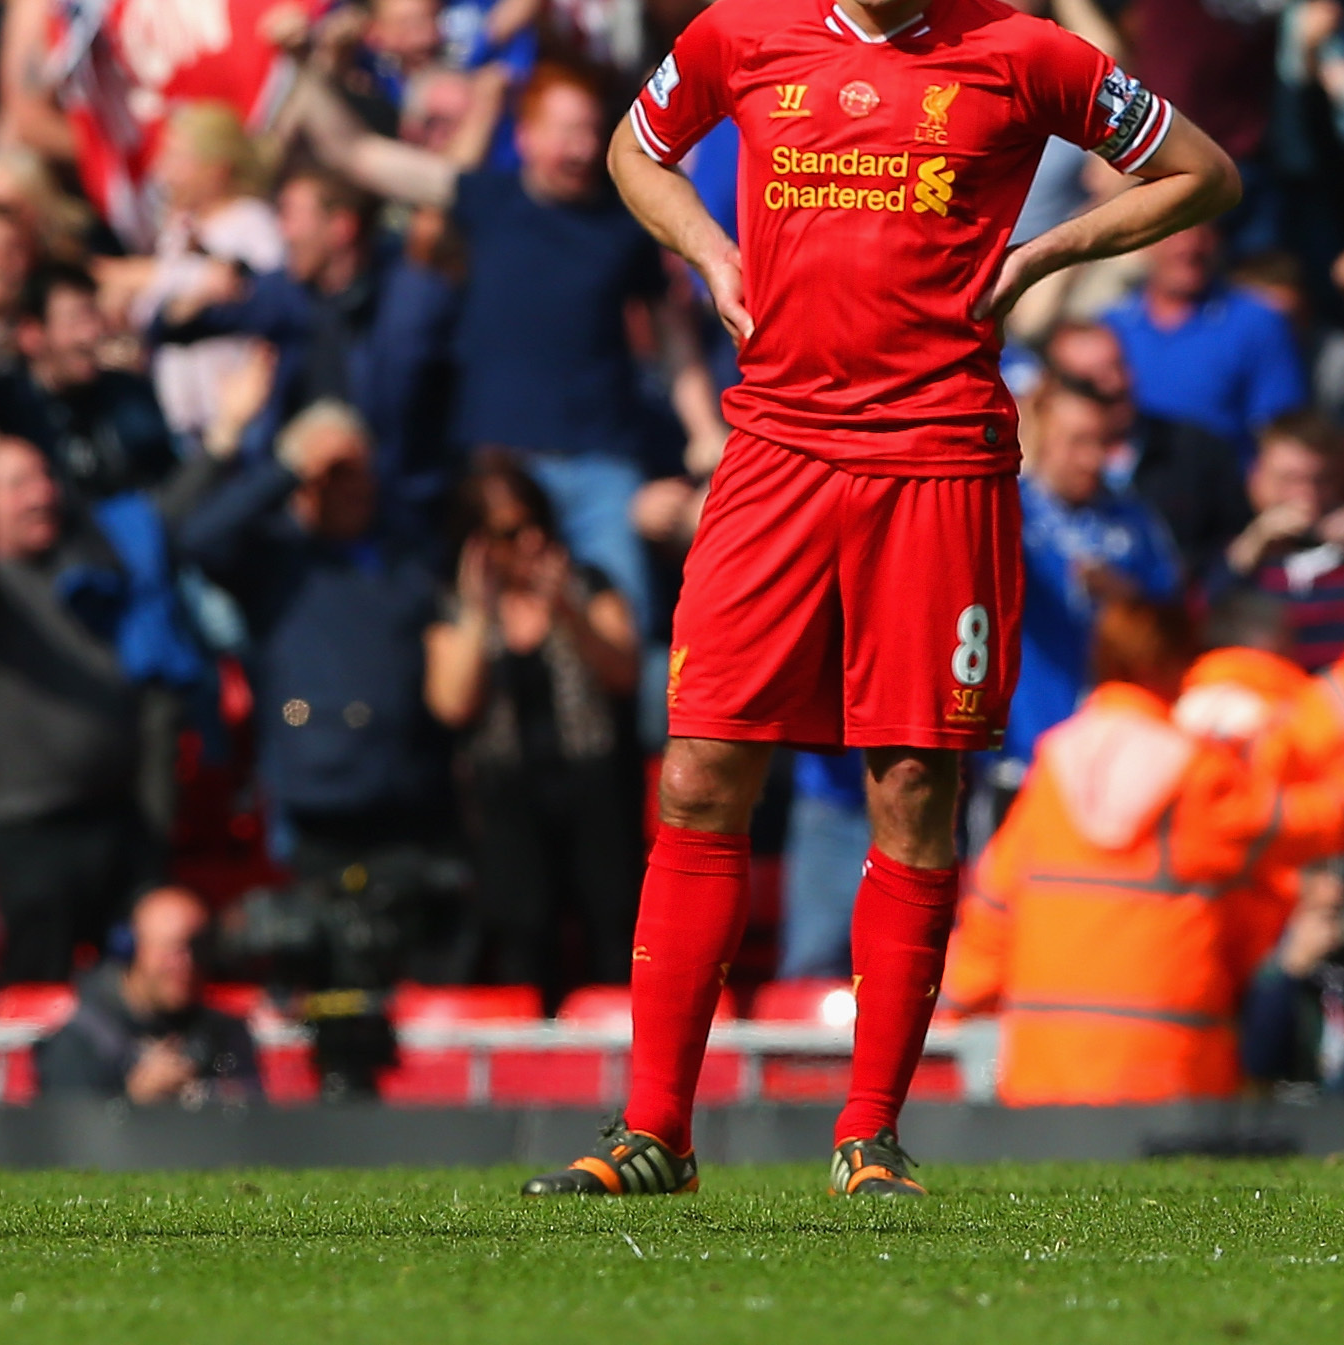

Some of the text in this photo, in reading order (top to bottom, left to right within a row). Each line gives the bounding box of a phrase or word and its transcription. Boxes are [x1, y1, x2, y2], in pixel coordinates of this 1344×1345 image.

[772, 146, 909, 178] Standard
[764, 181, 906, 212] Chartered
[951, 604, 990, 685] 8
